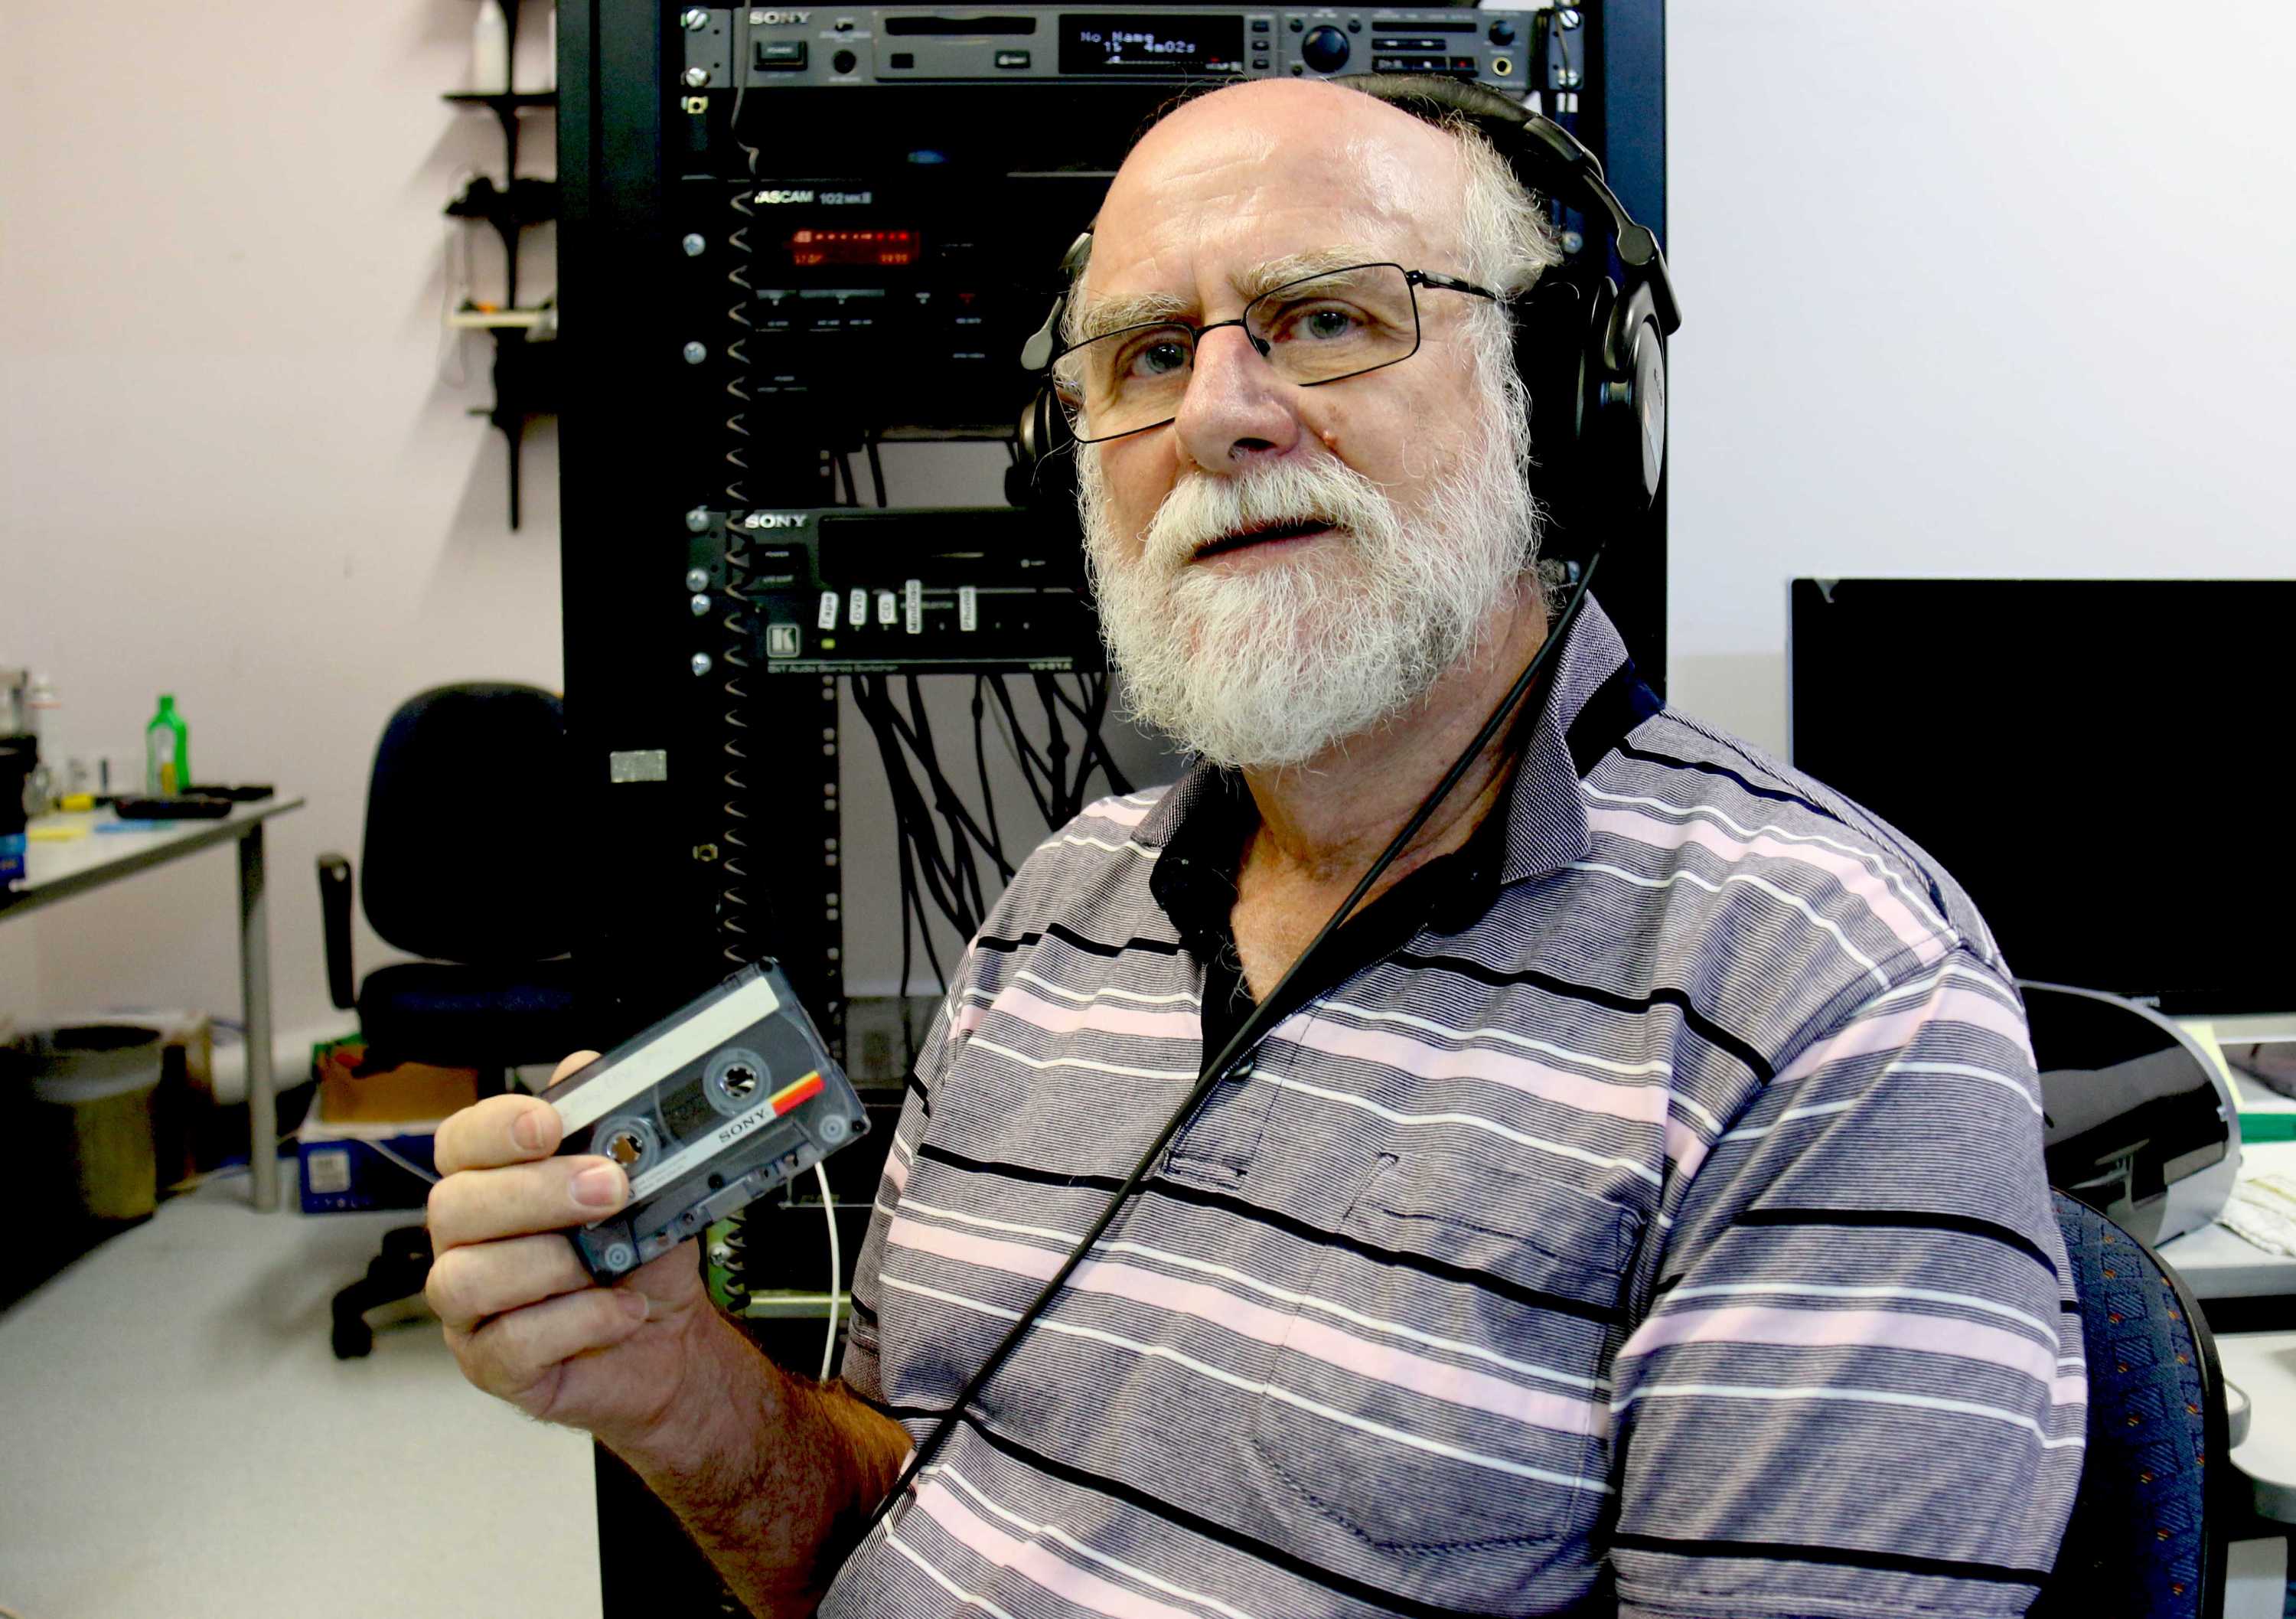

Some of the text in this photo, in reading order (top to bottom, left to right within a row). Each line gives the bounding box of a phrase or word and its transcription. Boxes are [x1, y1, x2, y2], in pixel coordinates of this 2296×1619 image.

[749, 11, 810, 24] SONY
[745, 513, 808, 528] SONY
[852, 592, 863, 621] DVD
[881, 601, 892, 620] CD
[719, 1108, 765, 1143] SONY
